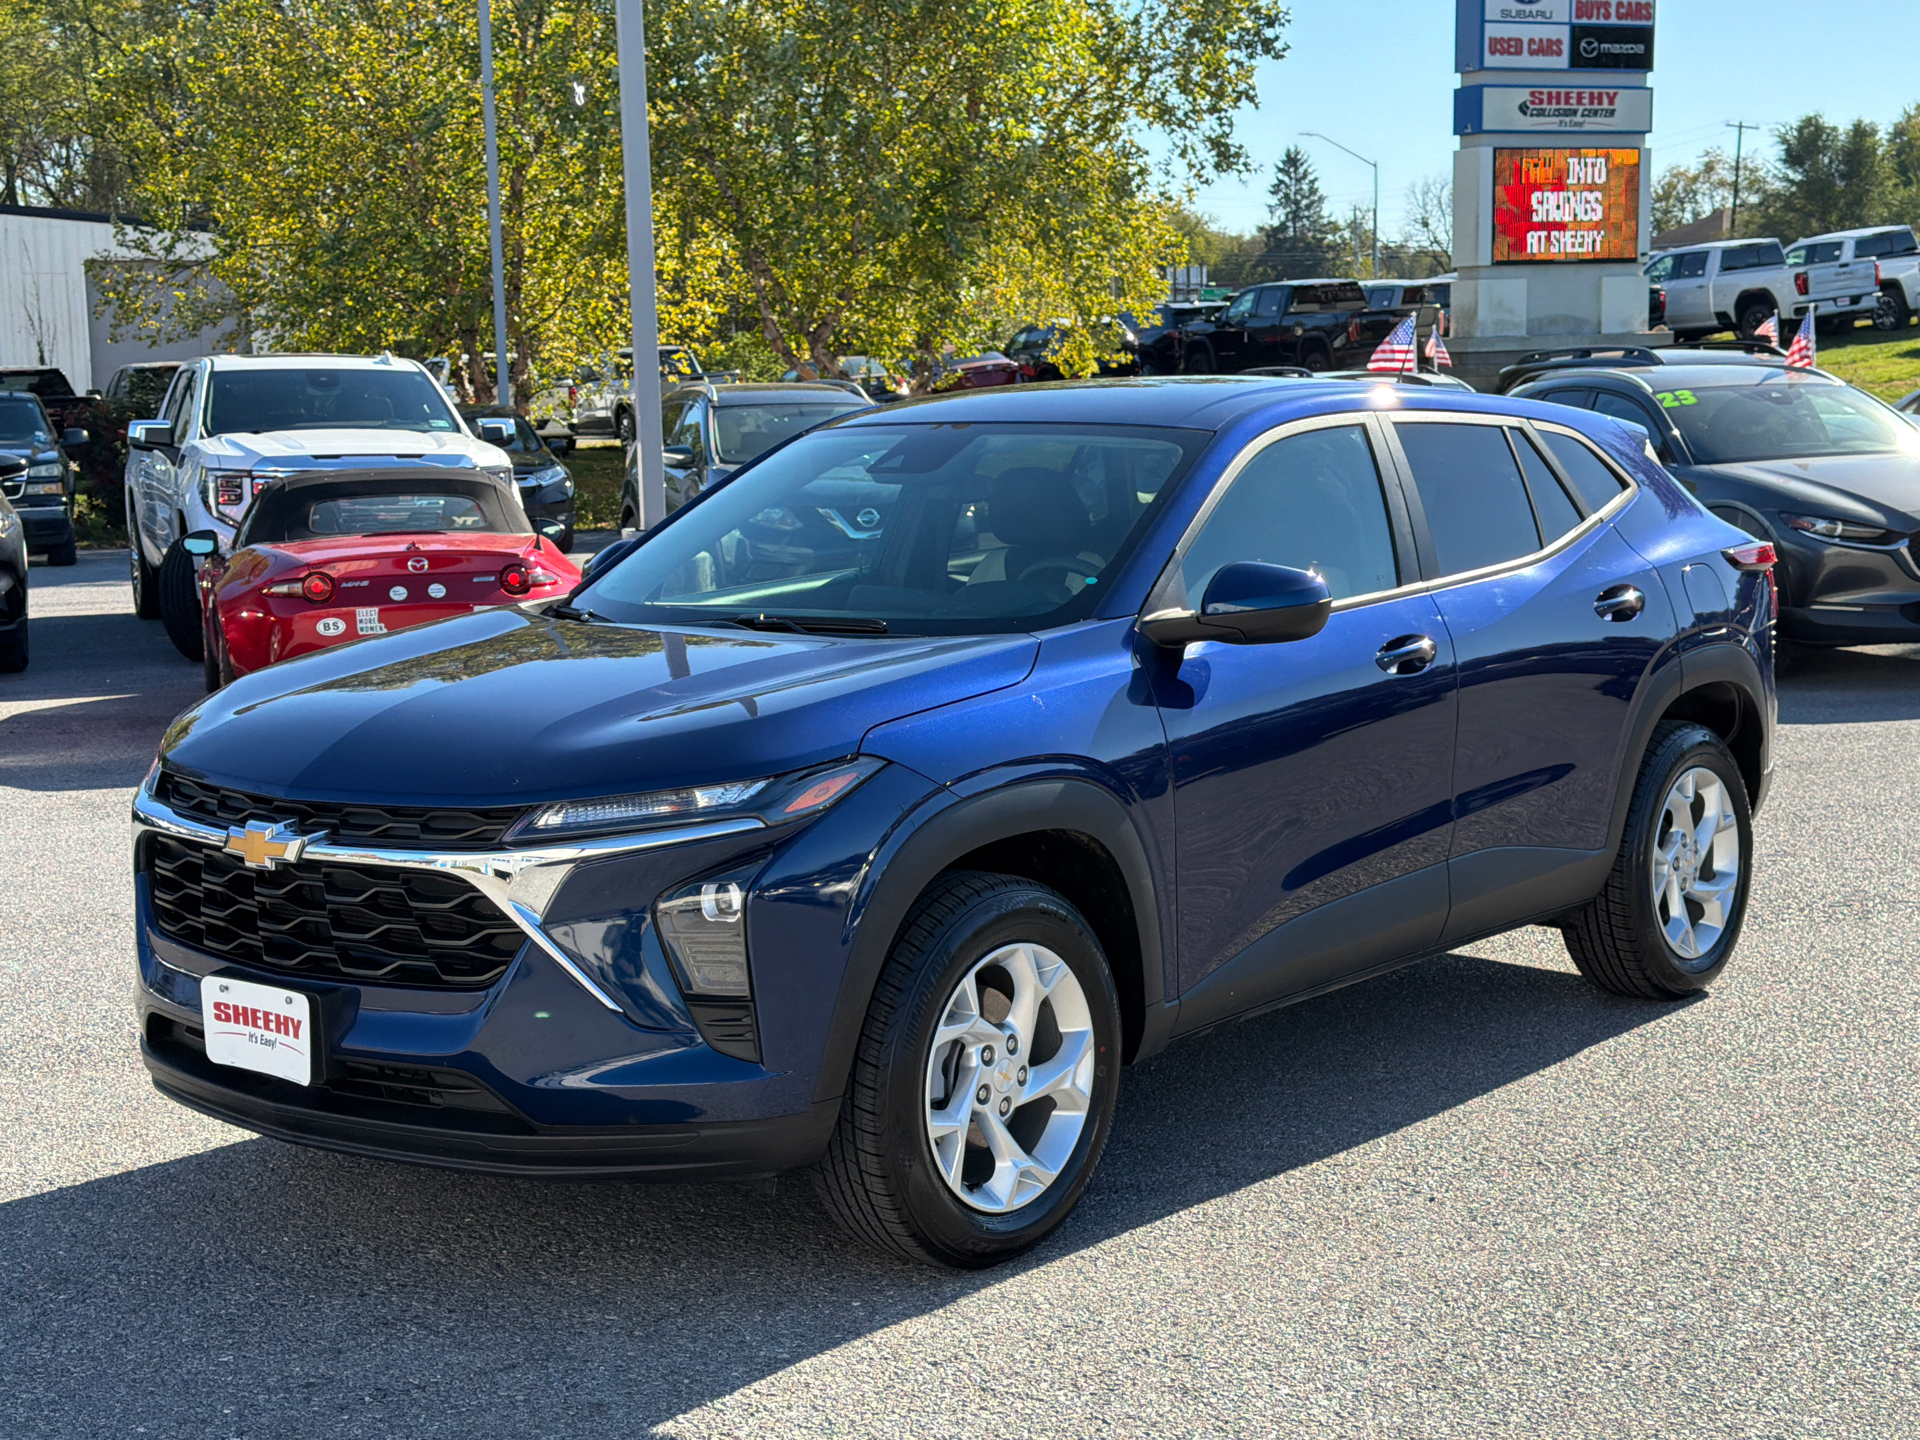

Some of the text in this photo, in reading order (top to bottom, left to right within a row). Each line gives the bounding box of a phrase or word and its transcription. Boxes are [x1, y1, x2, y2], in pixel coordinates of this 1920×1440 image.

[1500, 8, 1553, 20] SUBARU
[1575, 0, 1652, 22] BUYS CARS
[1488, 36, 1563, 57] USED CARS
[1600, 43, 1645, 54] mazda
[1529, 90, 1618, 106] SHEEHY
[1529, 108, 1616, 118] COLLISION CENTER
[1522, 158, 1606, 184] FALL INTO
[1531, 191, 1602, 222] SAVINGS
[1526, 230, 1604, 254] AT SHEEHY
[1656, 390, 1698, 408] 23
[322, 620, 340, 632] BS
[213, 1002, 302, 1040] SHEEHY
[248, 1032, 277, 1050] It's Easy!
